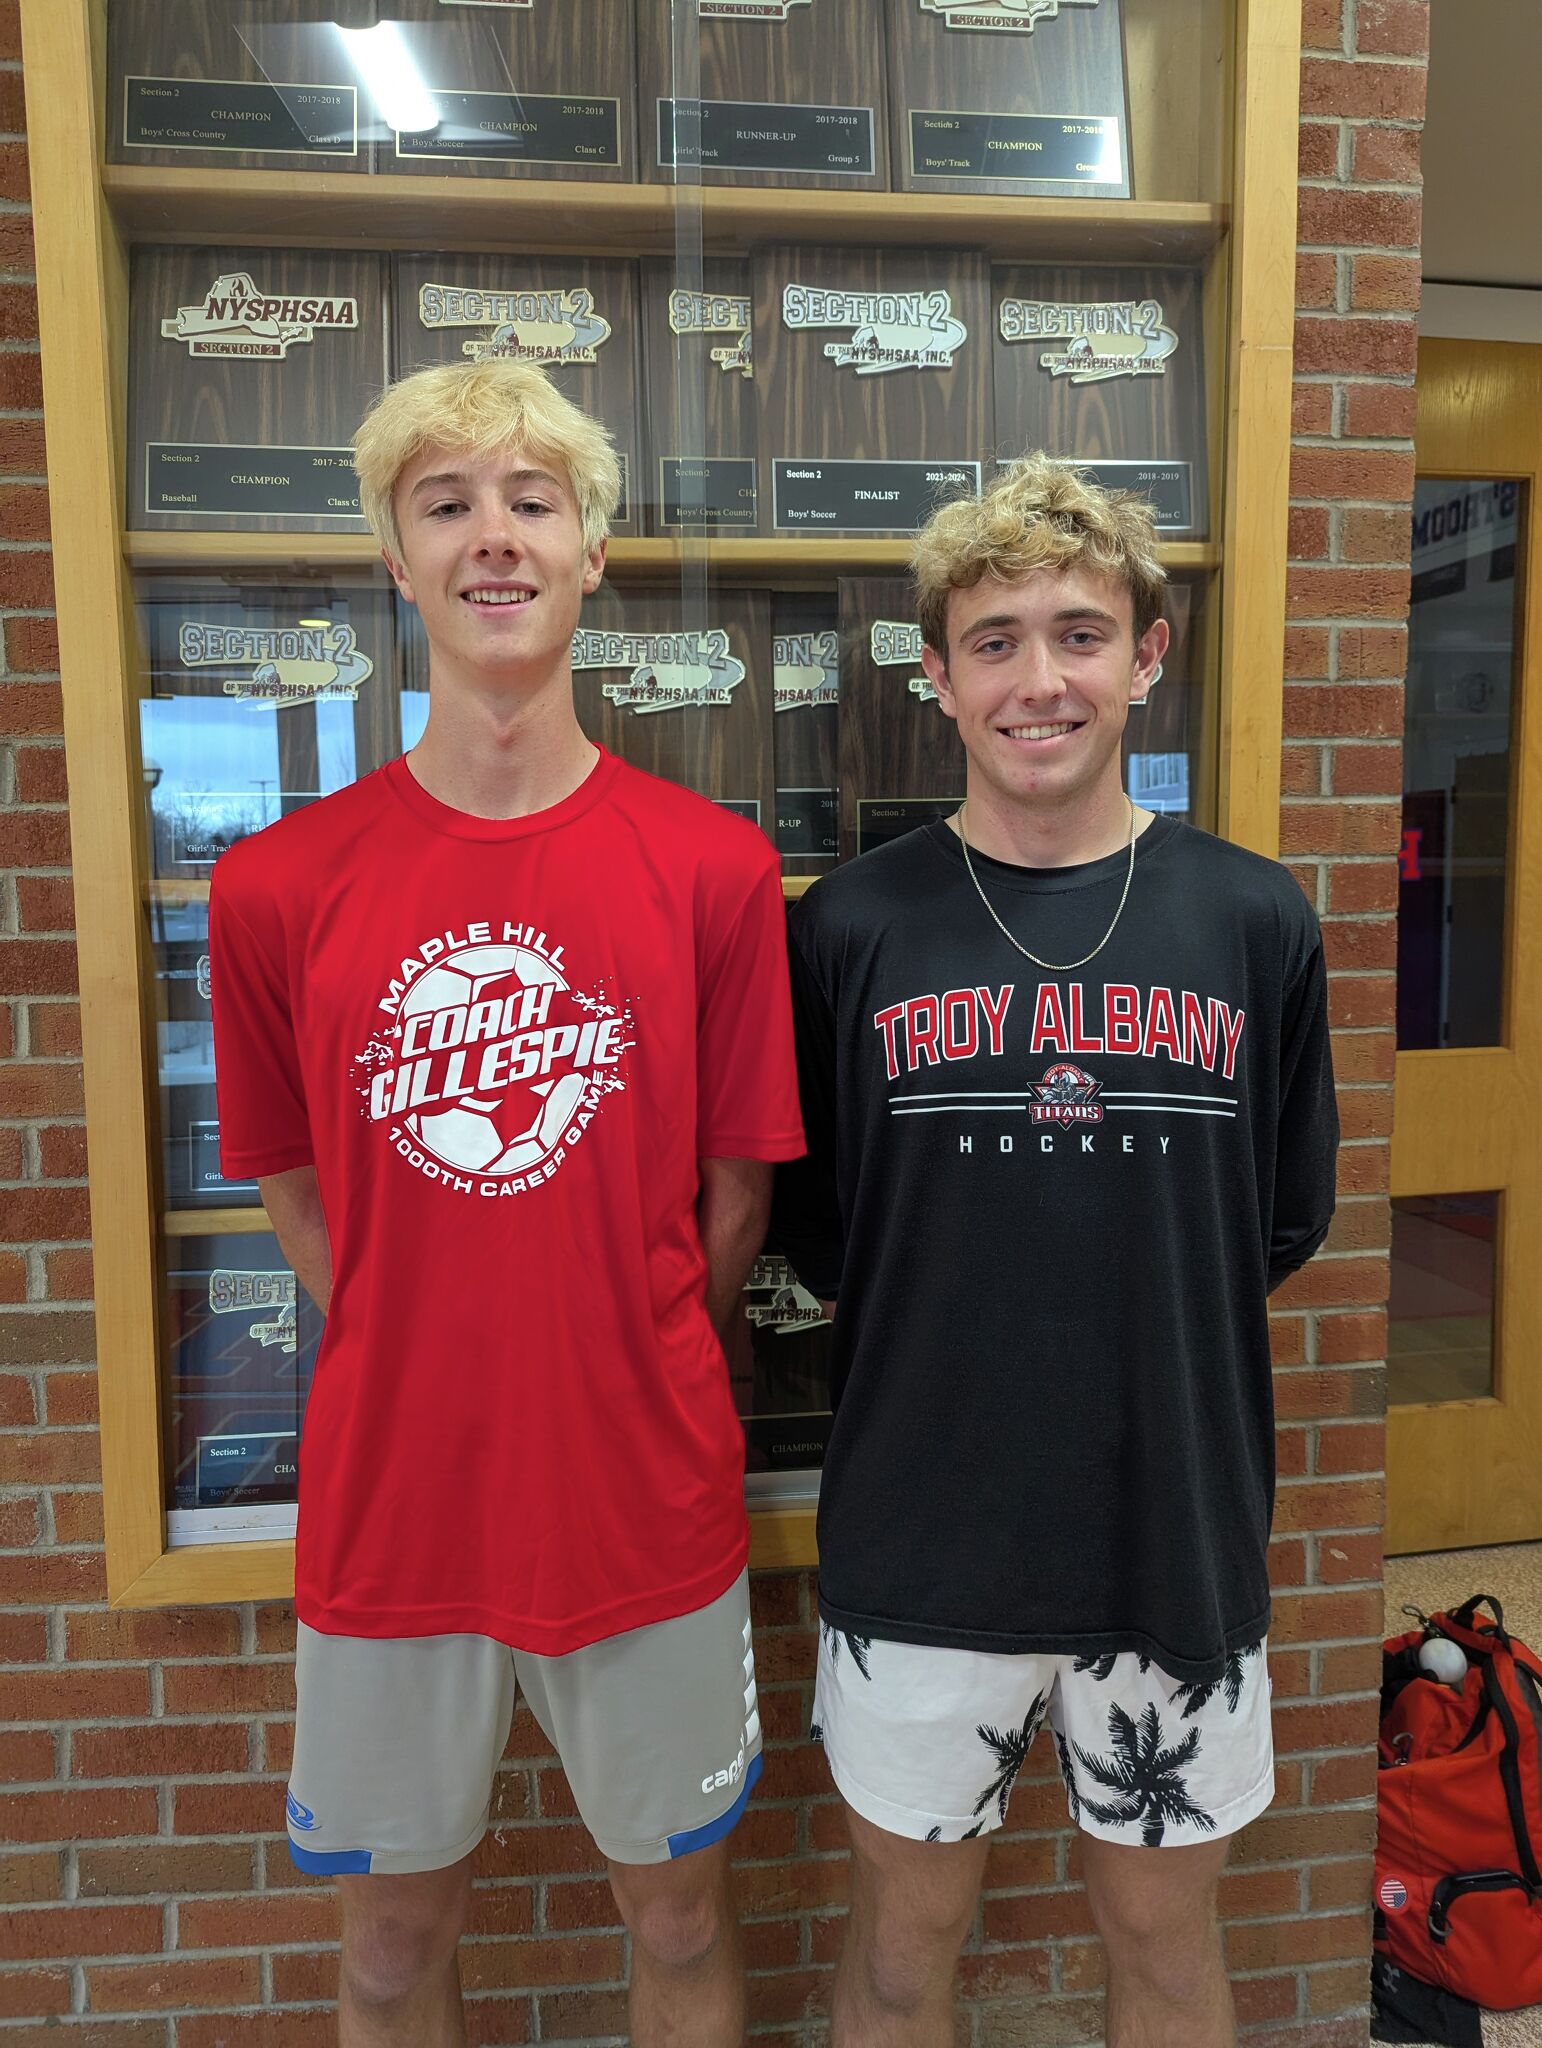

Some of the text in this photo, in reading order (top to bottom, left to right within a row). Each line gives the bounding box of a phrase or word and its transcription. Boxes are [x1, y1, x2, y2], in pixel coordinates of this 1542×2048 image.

[707, 4, 776, 15] SECTION 2
[957, 16, 1024, 27] SECTION 2
[140, 87, 180, 97] Section 2
[297, 95, 341, 105] 2017-2018
[211, 110, 271, 121] CHAMPION
[562, 106, 604, 116] 2017-2018
[703, 110, 710, 118] 2
[815, 115, 858, 125] 2017-2018
[924, 120, 960, 129] Section 2
[479, 121, 538, 132] CHAMPION
[141, 127, 227, 140] Boys' Cross Country
[736, 130, 796, 141] RUNNER-UP
[308, 134, 341, 144] Class D
[412, 138, 465, 148] Boys' Soccer
[575, 145, 606, 154] Class C
[988, 141, 1042, 151] CHAMPION
[828, 154, 860, 164] Group 5
[926, 158, 971, 168] Boys' Track
[206, 298, 354, 324] NYSPHSAA
[423, 287, 591, 328] SECTION 2
[786, 287, 949, 331] SECTION 2
[1003, 301, 1160, 340] SECTION 2
[201, 343, 274, 354] SECTION 2
[569, 346, 594, 359] INC.
[838, 347, 850, 355] THE
[926, 351, 950, 363] INC.
[161, 453, 200, 463] Section 2
[312, 458, 357, 467] 2017-201
[675, 469, 703, 477] Section
[786, 470, 822, 479] Section 2
[926, 472, 965, 481] 2023-2024
[1138, 472, 1179, 481] 2018-2019
[231, 475, 290, 485] CHAMPION
[162, 493, 197, 503] Baseball
[854, 491, 900, 500] FINALIST
[327, 498, 359, 507] Class C
[699, 508, 722, 516] Cross
[722, 509, 753, 518] Country
[788, 510, 837, 519] Boys' Soccer
[1173, 511, 1180, 519] C
[183, 625, 354, 667] SECTION 2
[571, 632, 727, 670] SECTION 2
[819, 633, 838, 669] 2
[226, 683, 235, 691] OF
[238, 684, 250, 692] THE
[705, 688, 728, 700] INC.
[872, 808, 906, 817] Section 2
[379, 921, 568, 1015] MAPLE HILL
[401, 982, 556, 1058] COACH
[874, 983, 1245, 1081] TROY ALBANY
[370, 1017, 624, 1120] GILLESPIE
[1033, 1106, 1099, 1120] TITANS
[388, 1069, 605, 1197] 1000TH CAREER GAME
[959, 1135, 1170, 1154] HOCKEY
[213, 1273, 293, 1309] SECT
[240, 1447, 246, 1455] 2
[772, 1442, 823, 1453] CHAMPION
[234, 1487, 260, 1496] Soccer
